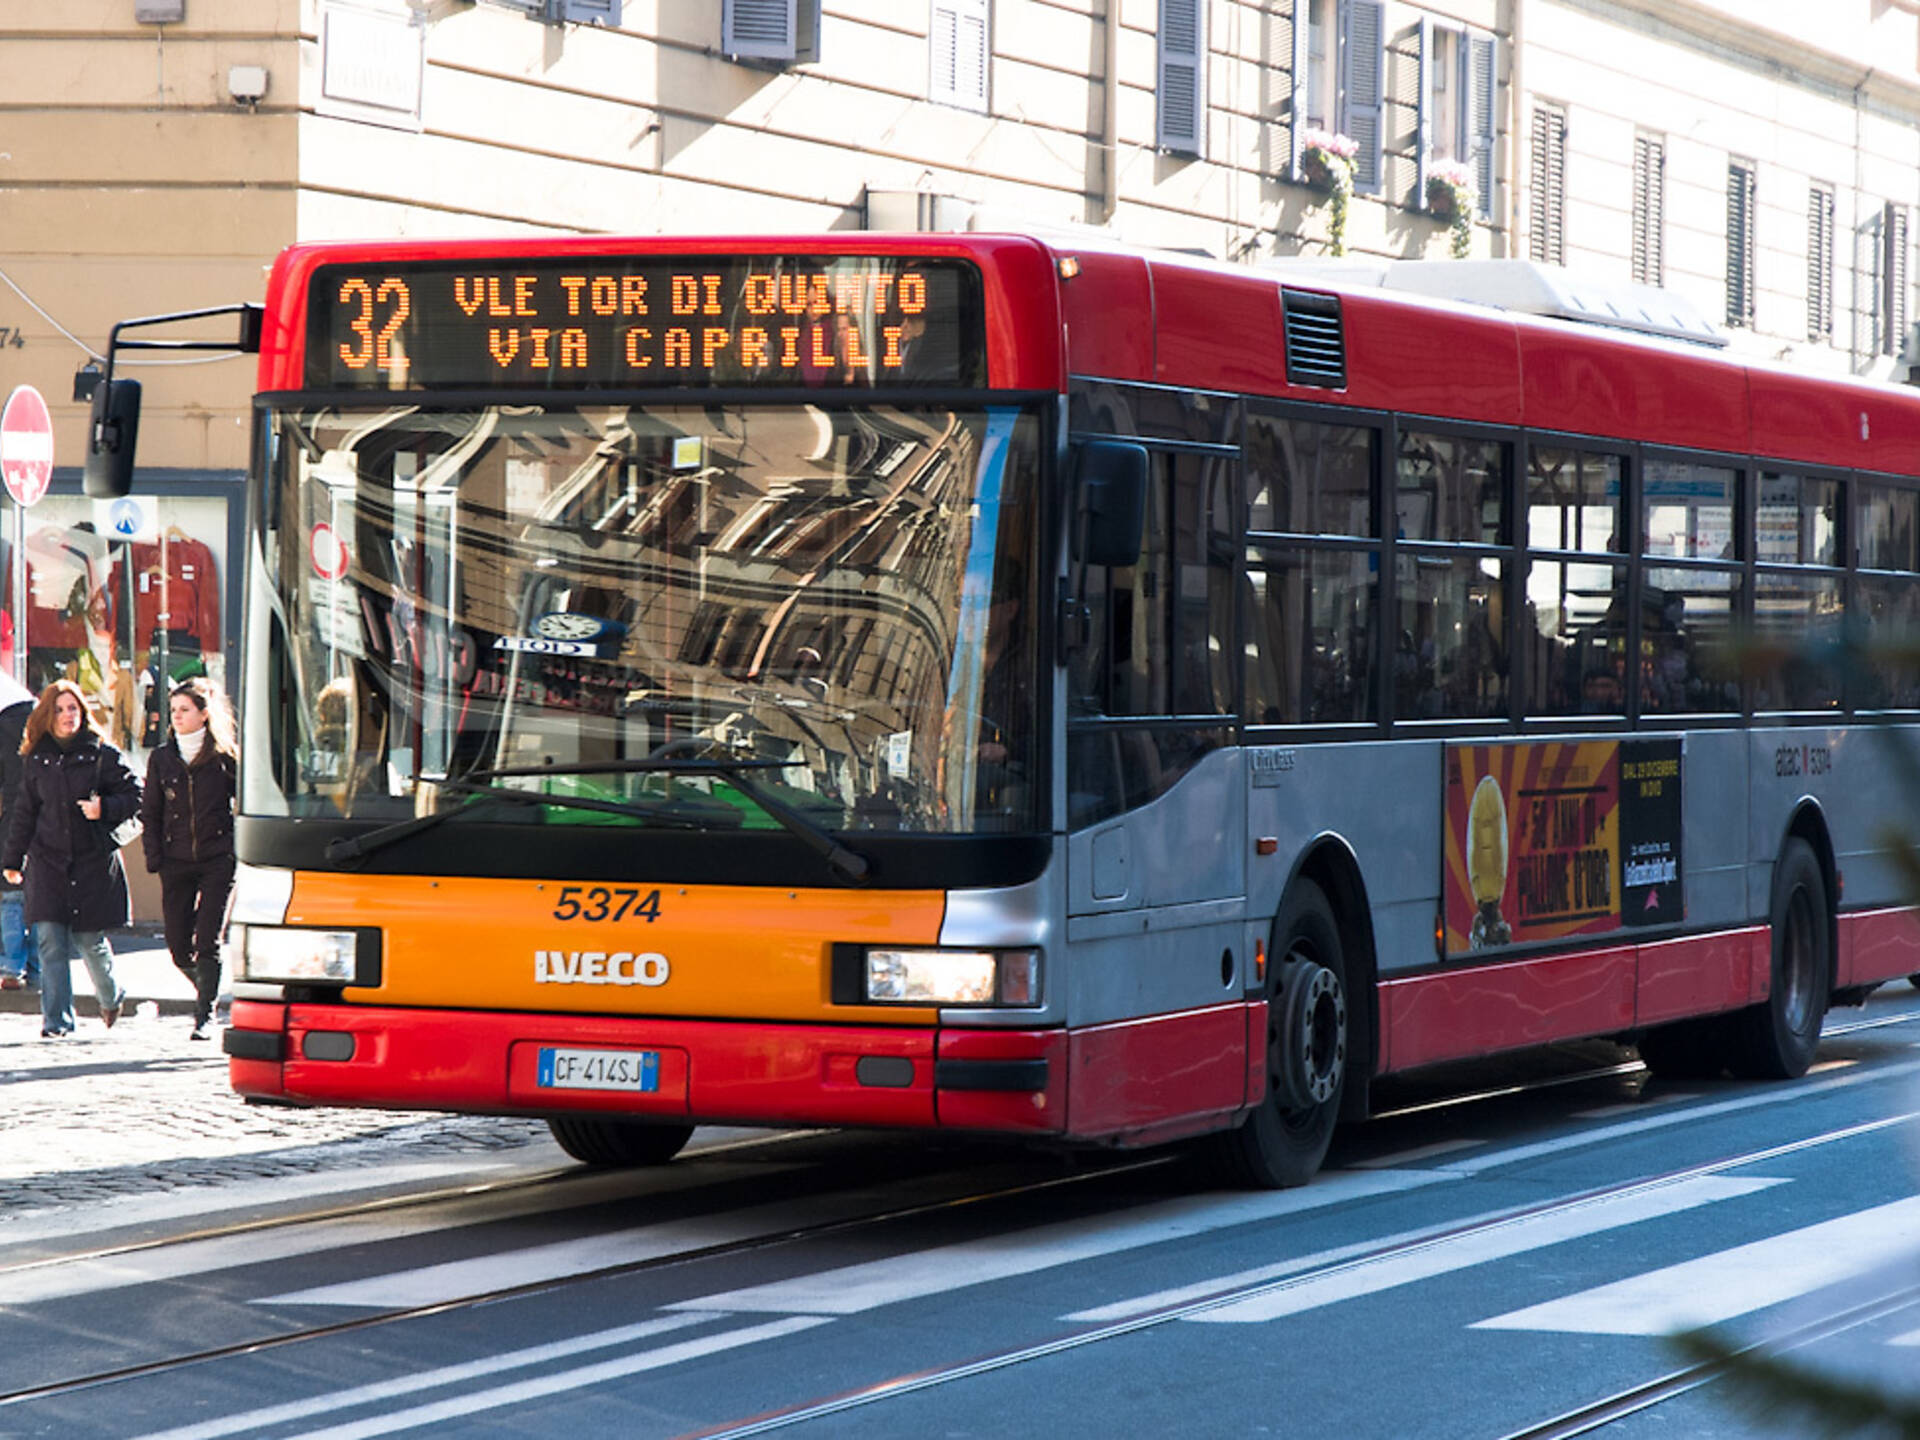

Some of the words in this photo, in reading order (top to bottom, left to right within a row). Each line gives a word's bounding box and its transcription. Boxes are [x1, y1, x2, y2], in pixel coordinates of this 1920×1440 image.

[454, 277, 538, 316] VLE
[560, 276, 648, 315] TOR
[672, 275, 721, 315] DI
[745, 273, 926, 314] QUINTO
[339, 278, 410, 368] 32
[489, 328, 587, 368] VIA
[626, 326, 902, 368] CAPRILLI
[553, 887, 662, 923] 5374
[535, 951, 670, 986] IVECO
